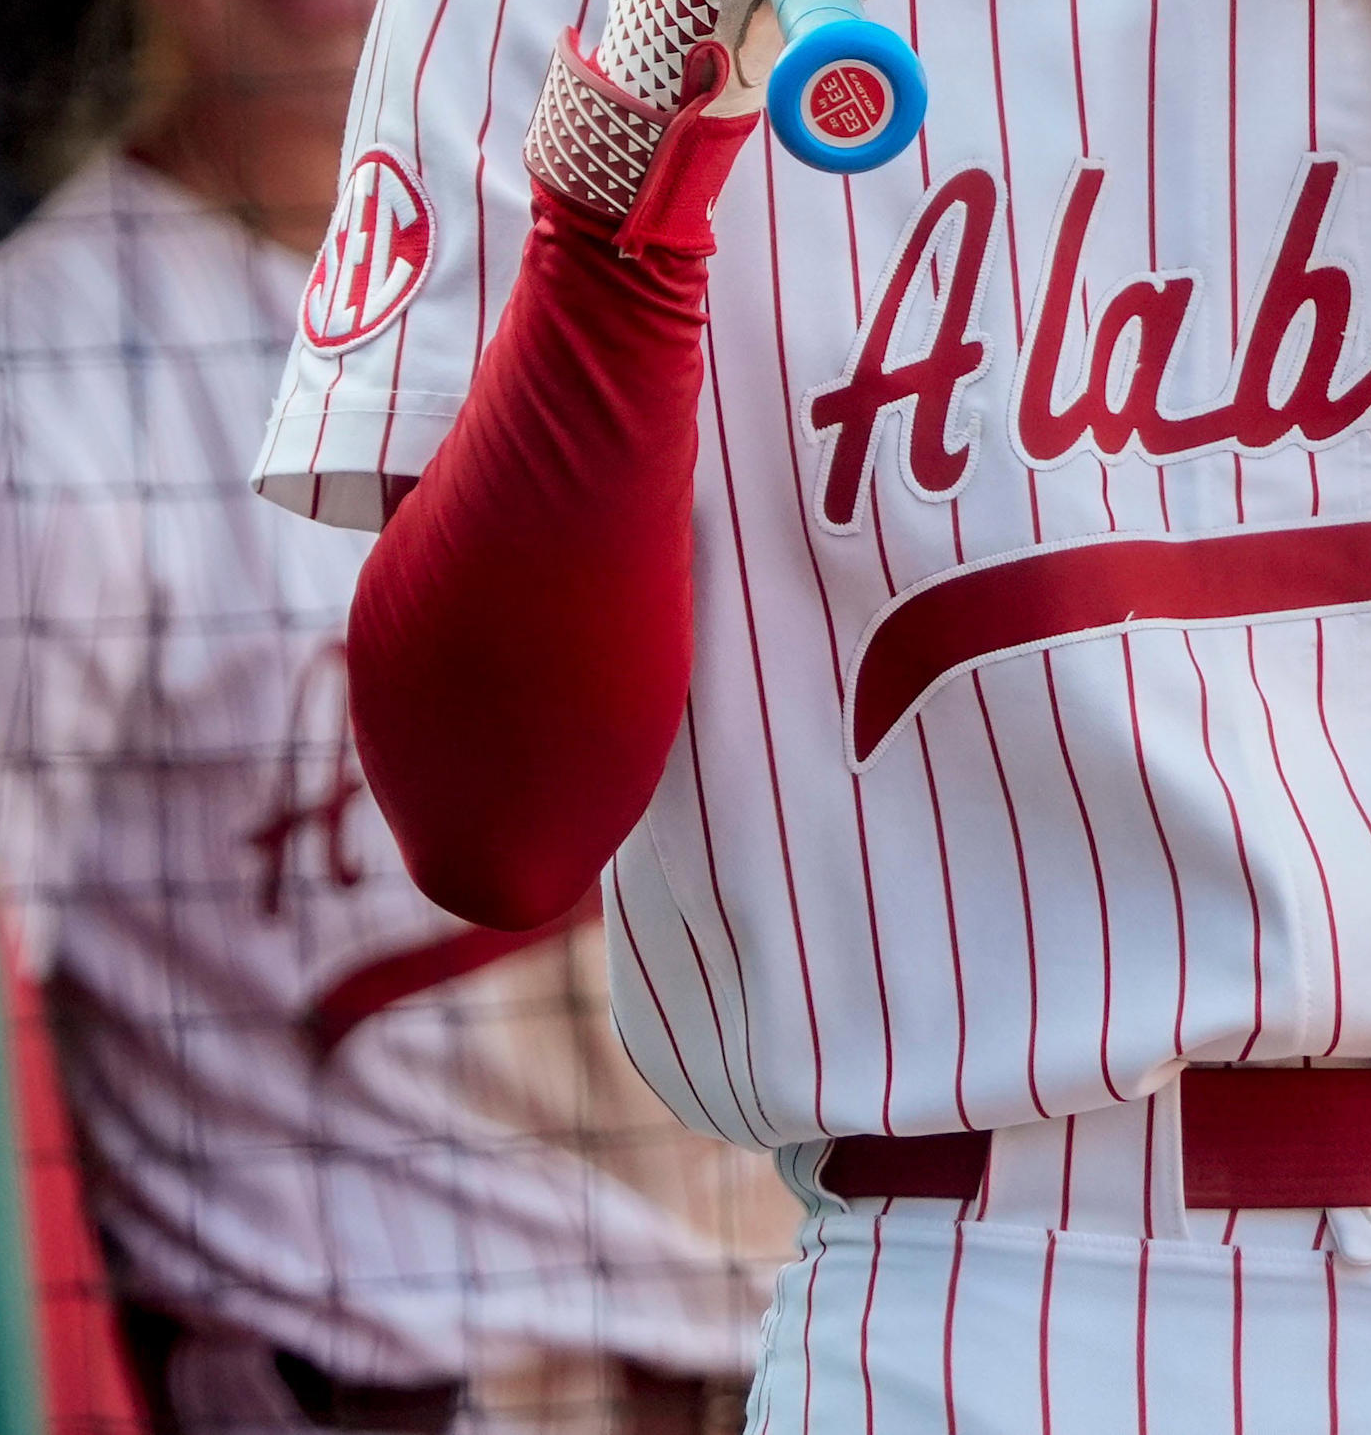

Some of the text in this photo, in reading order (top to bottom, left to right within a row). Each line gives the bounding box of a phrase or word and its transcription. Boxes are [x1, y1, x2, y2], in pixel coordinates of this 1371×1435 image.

[821, 77, 845, 103] 33
[848, 73, 877, 114] EASTON
[818, 97, 829, 110] in
[838, 108, 863, 133] 23
[308, 161, 418, 338] SEC
